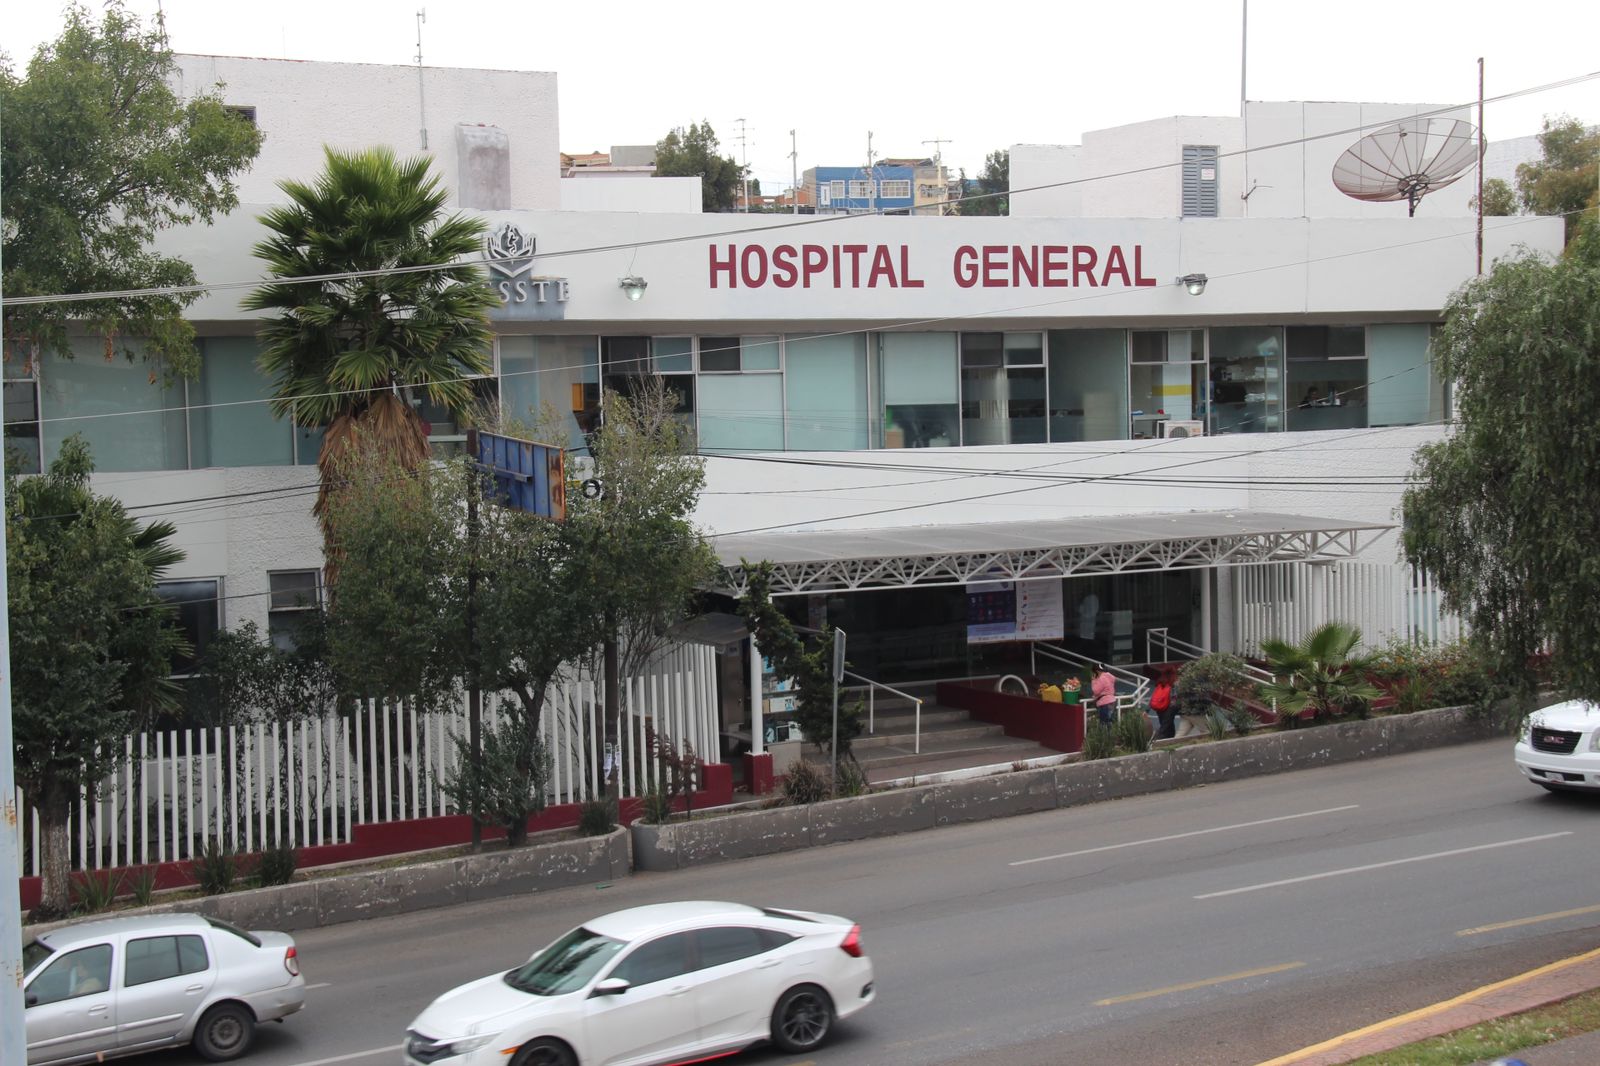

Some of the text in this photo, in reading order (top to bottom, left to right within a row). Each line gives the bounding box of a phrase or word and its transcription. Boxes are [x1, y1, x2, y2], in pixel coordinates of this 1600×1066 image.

[709, 244, 1156, 288] HOSPITAL GENERAL
[487, 279, 570, 303] SSTE
